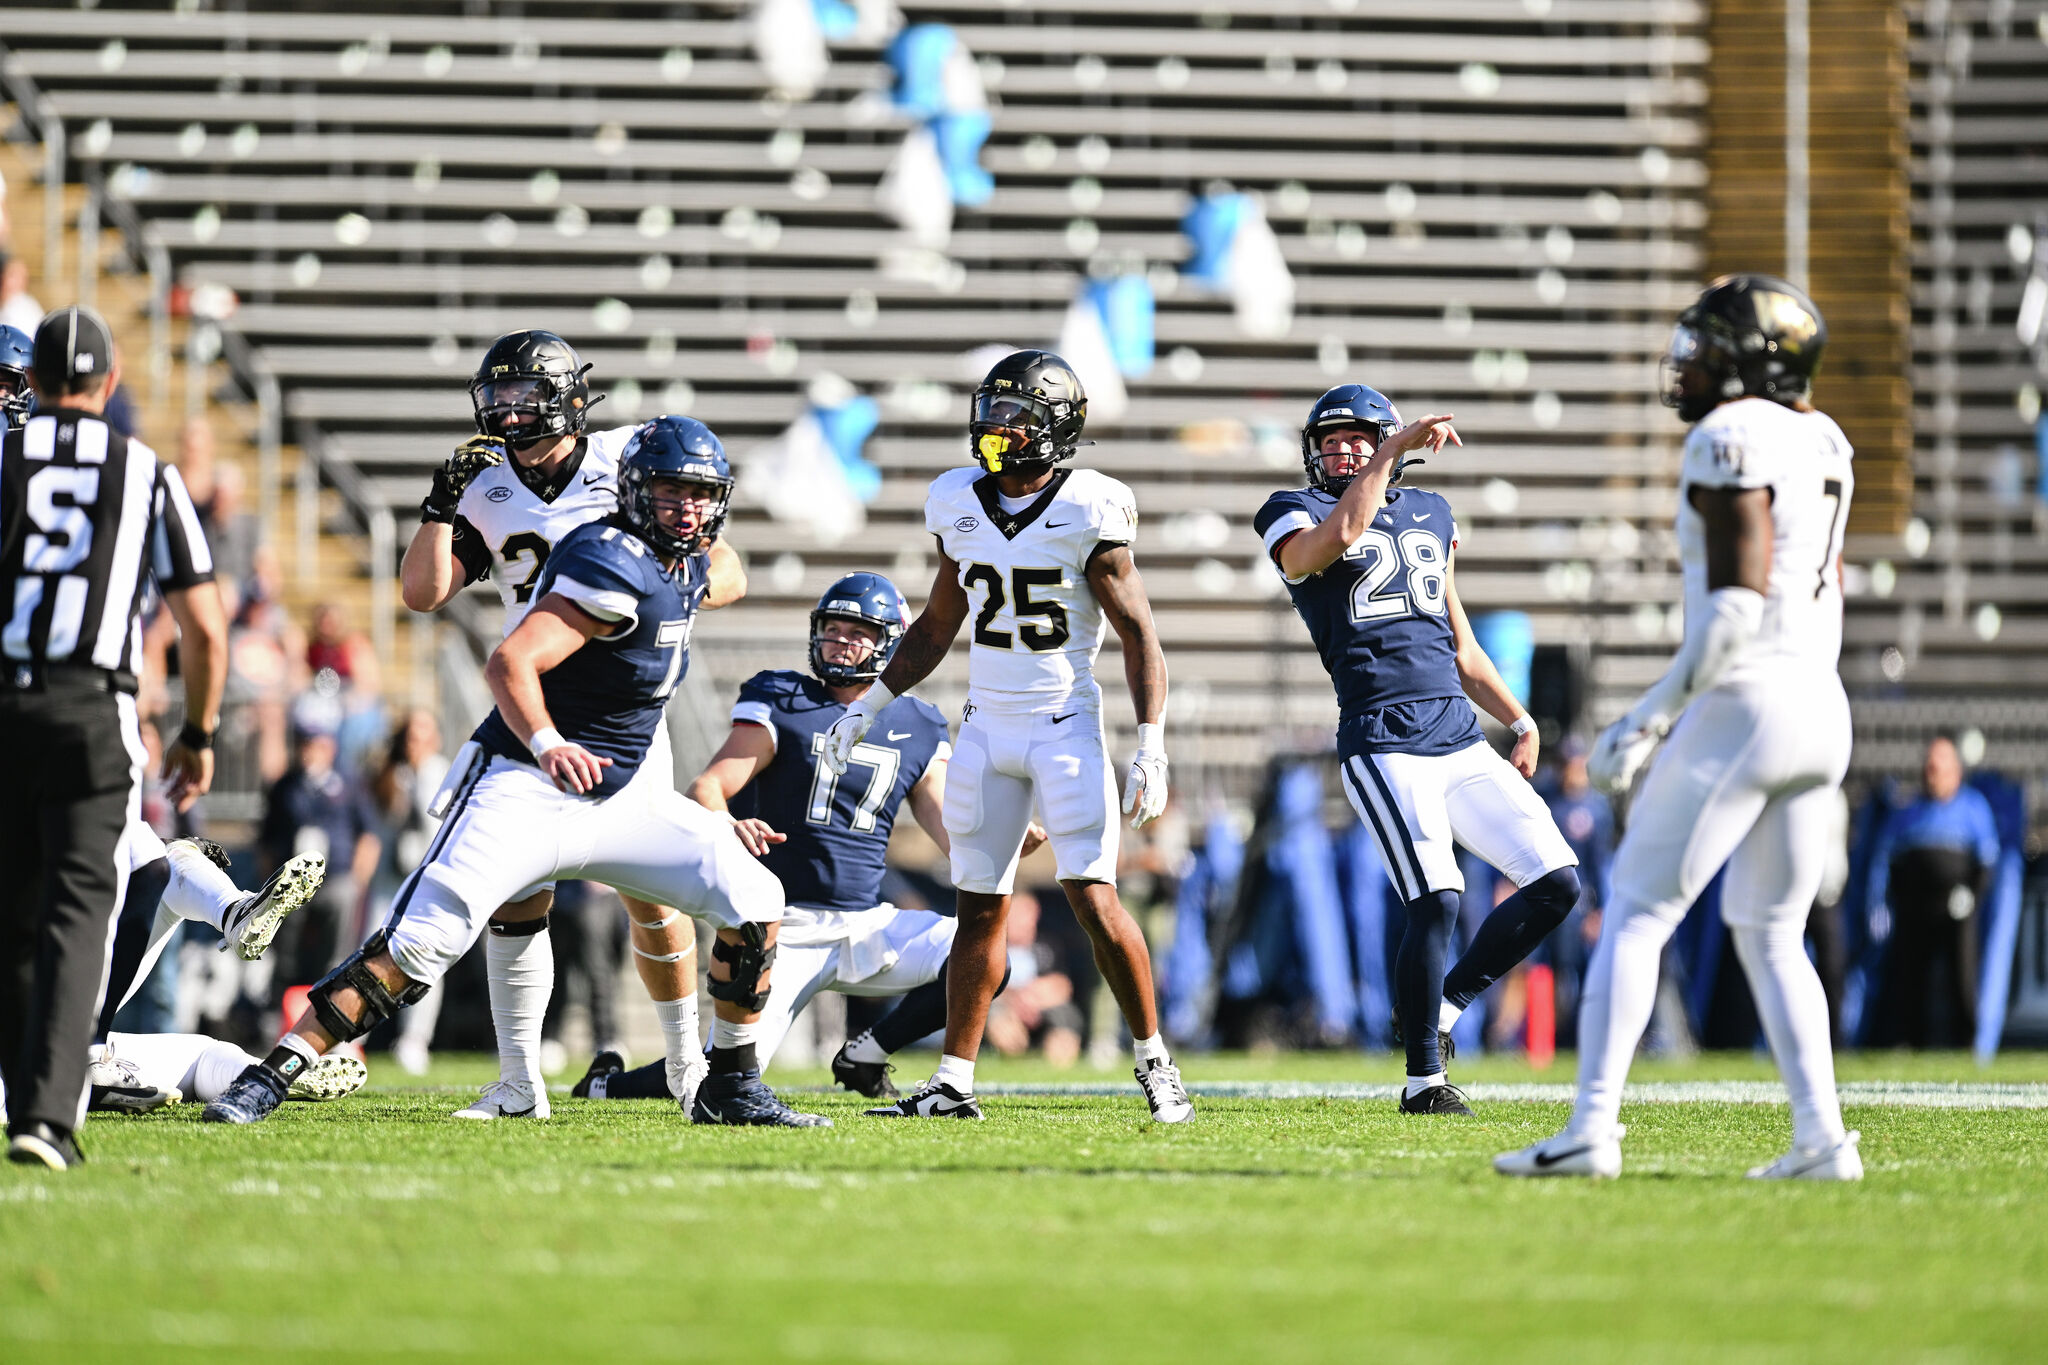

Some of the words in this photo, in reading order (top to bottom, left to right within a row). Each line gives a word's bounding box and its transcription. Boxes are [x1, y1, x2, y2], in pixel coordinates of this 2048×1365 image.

[23, 466, 99, 573] S
[488, 488, 511, 499] ACC
[956, 518, 977, 529] ACC
[1813, 478, 1842, 601] 7
[499, 529, 552, 605] 2
[964, 560, 1071, 654] 25
[1343, 529, 1448, 623] 28
[655, 618, 700, 700] 7
[805, 732, 901, 834] 17
